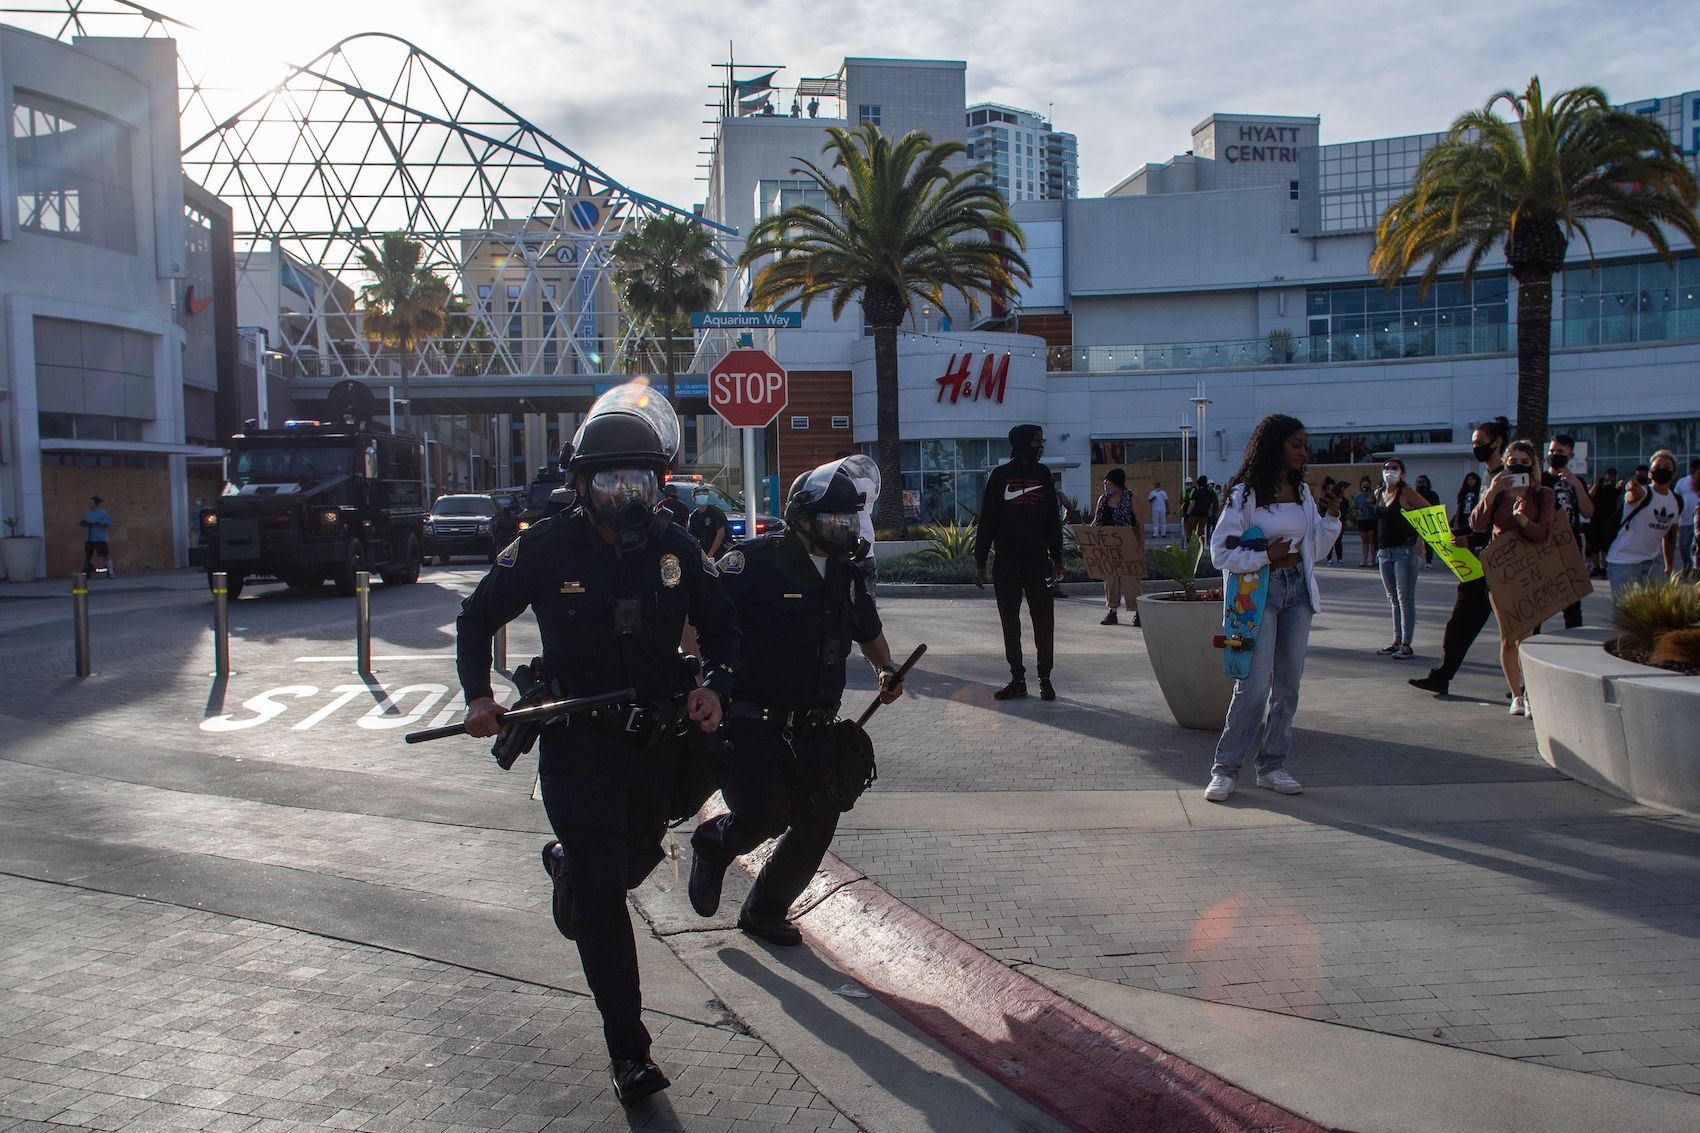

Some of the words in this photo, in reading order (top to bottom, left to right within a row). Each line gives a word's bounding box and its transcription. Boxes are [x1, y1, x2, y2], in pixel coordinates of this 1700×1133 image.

[1239, 125, 1300, 143] HYATT
[1224, 145, 1299, 164] CENTRI
[703, 314, 760, 328] Aquarium
[764, 314, 790, 328] Way
[714, 372, 783, 404] STOP
[935, 352, 1011, 405] H&M
[1092, 547, 1125, 560] OVER
[1486, 538, 1517, 569] KEEP
[1498, 551, 1536, 585] VOICE
[1520, 565, 1542, 588] IN
[1504, 567, 1584, 633] NOVEMBER
